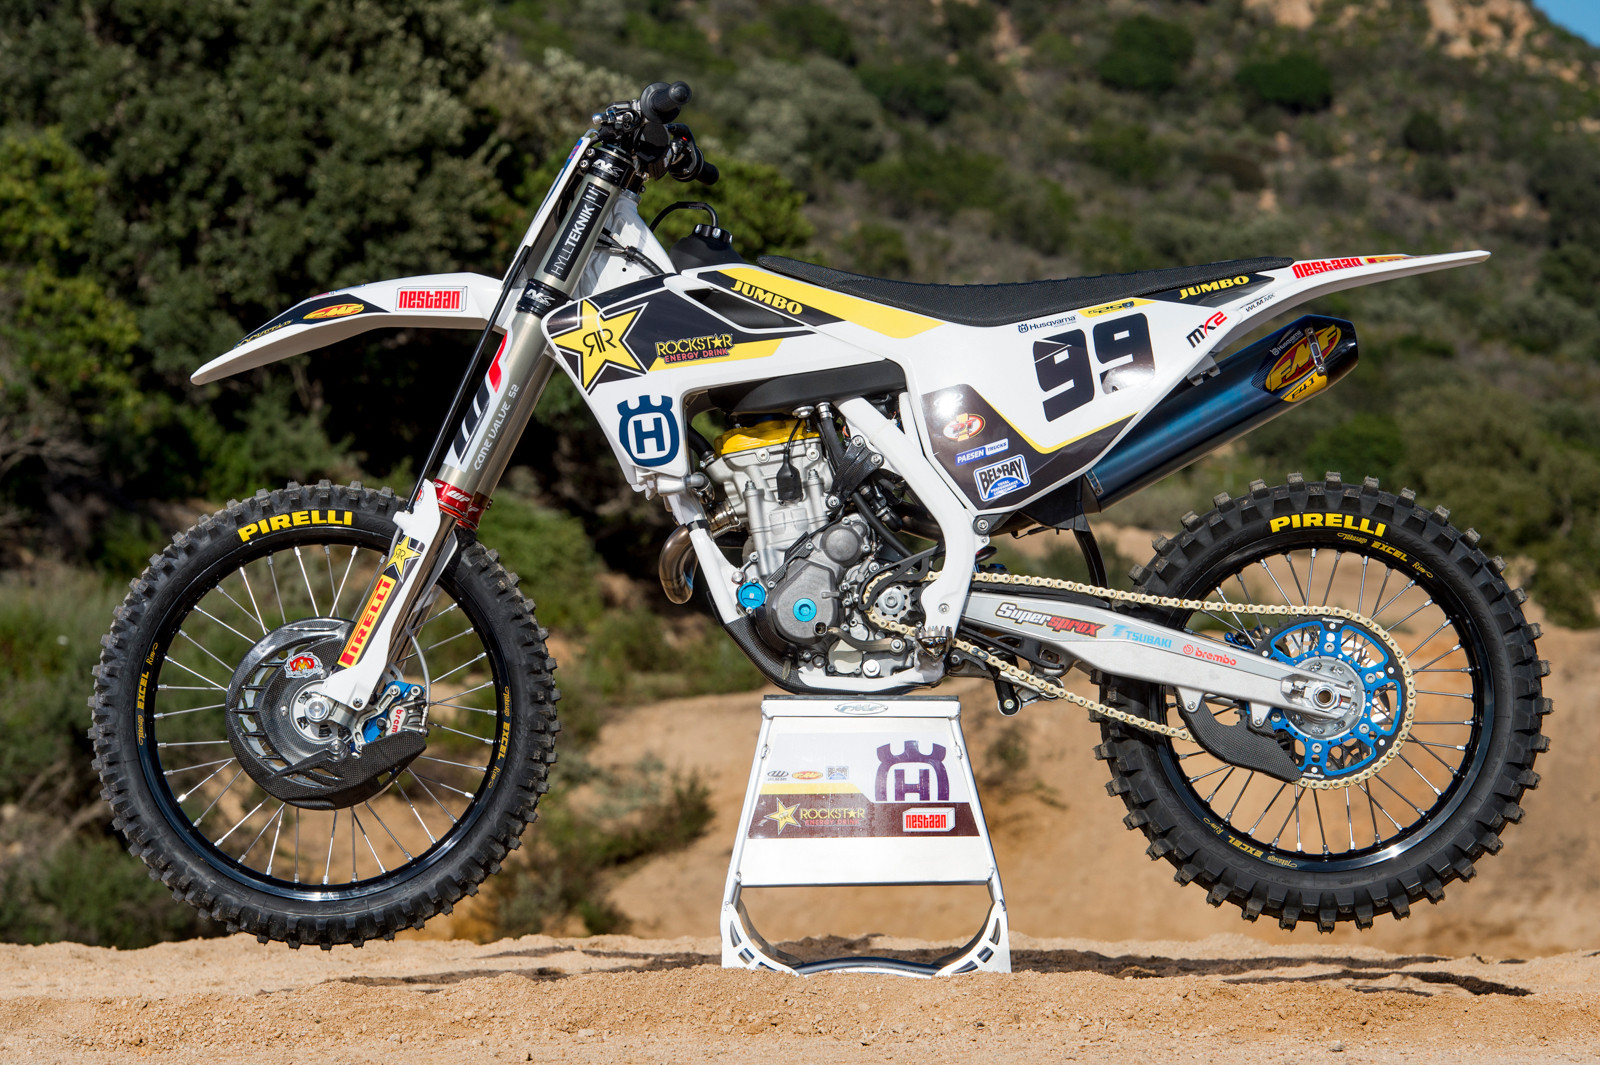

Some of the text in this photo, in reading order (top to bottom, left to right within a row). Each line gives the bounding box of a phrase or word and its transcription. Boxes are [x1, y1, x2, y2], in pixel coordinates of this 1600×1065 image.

[550, 204, 595, 276] HYLLTEKNIK
[399, 290, 460, 309] nestaan
[731, 279, 803, 315] JUMBO
[1179, 275, 1250, 300] JUMBO
[1029, 315, 1076, 331] Husqvarna
[1186, 311, 1227, 349] MX2
[664, 348, 728, 363] ENERGY DRINK
[1033, 313, 1156, 423] 99
[473, 440, 492, 471] CONE
[490, 401, 511, 440] VALVE
[957, 449, 985, 464] PAESEN
[237, 509, 353, 542] PIRELLI
[1269, 512, 1387, 538] PIRELLI
[1370, 540, 1408, 562] EXCEL
[1125, 631, 1172, 649] TSUBAKI
[1195, 647, 1237, 666] brembo
[137, 671, 150, 710] EXCEL
[497, 721, 510, 760] EXCEL
[905, 814, 947, 829] nestaan
[1228, 835, 1264, 858] EXCEL
